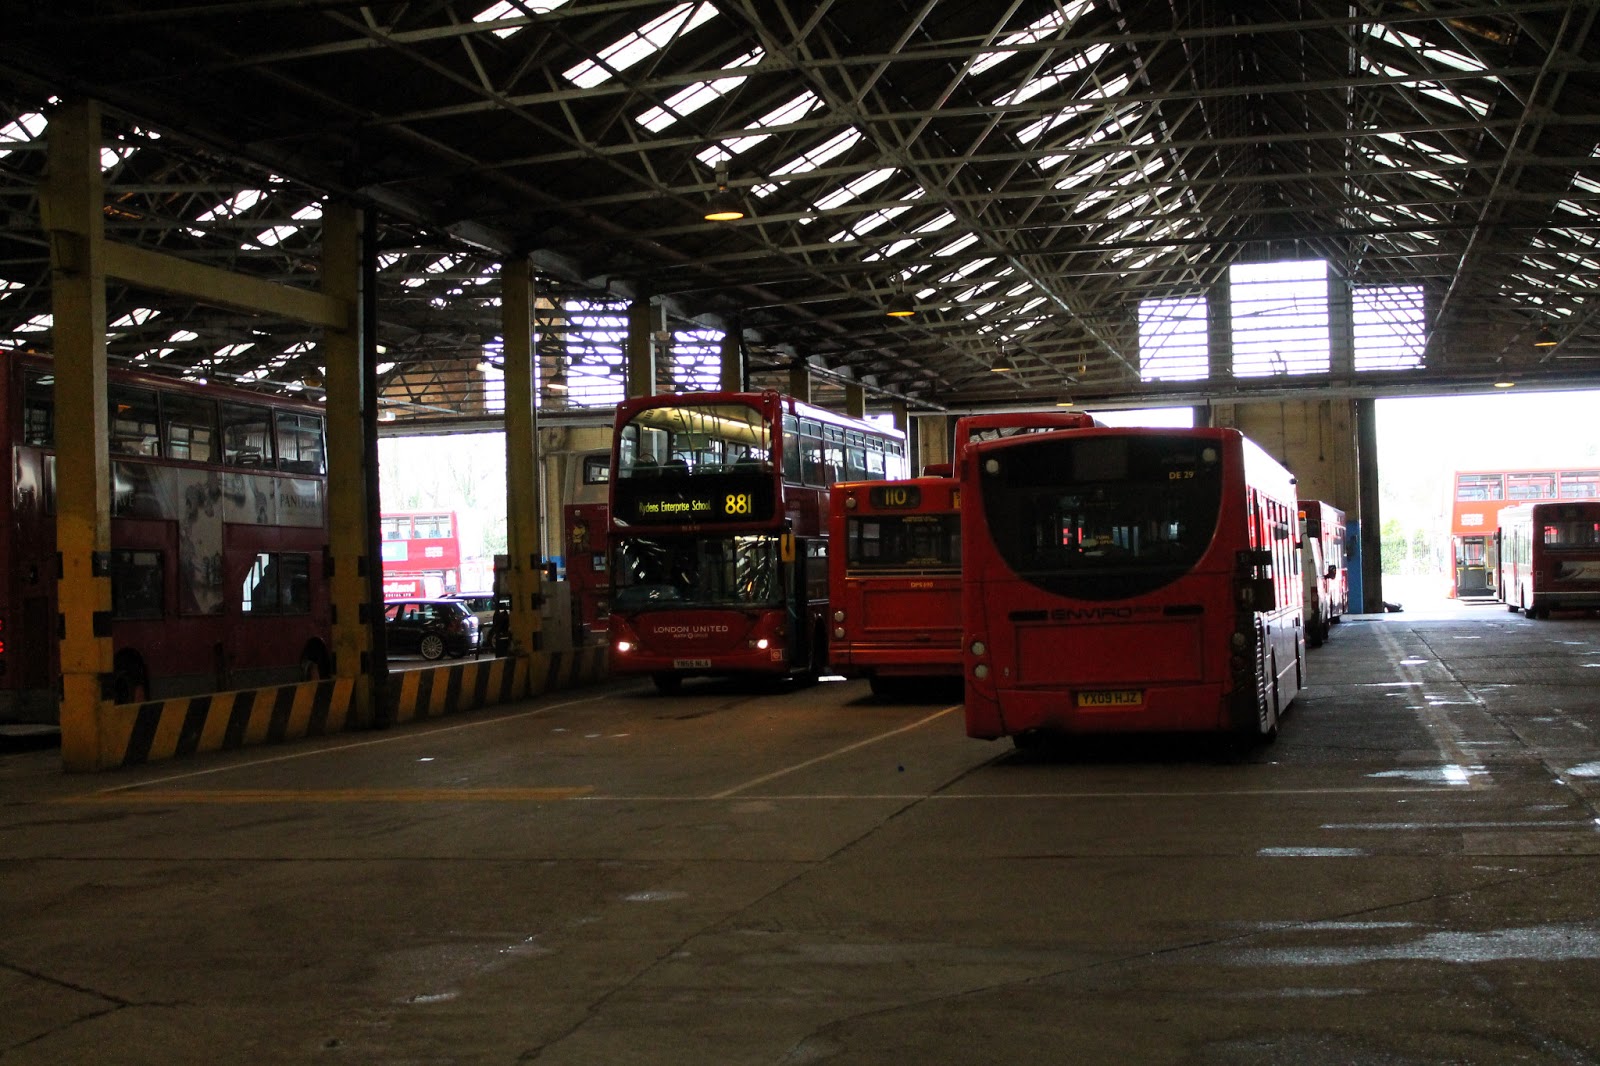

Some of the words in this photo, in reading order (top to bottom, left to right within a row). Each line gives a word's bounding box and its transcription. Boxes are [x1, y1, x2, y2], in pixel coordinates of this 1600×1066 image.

[1169, 471, 1181, 480] DE
[1184, 470, 1194, 478] 29
[885, 488, 907, 505] 110
[661, 501, 690, 514] Enterprise
[692, 500, 712, 511] School
[725, 494, 752, 514] 881
[1052, 606, 1132, 620] ENVIRO
[1082, 694, 1112, 704] YX09
[1115, 693, 1137, 703] HJZ
